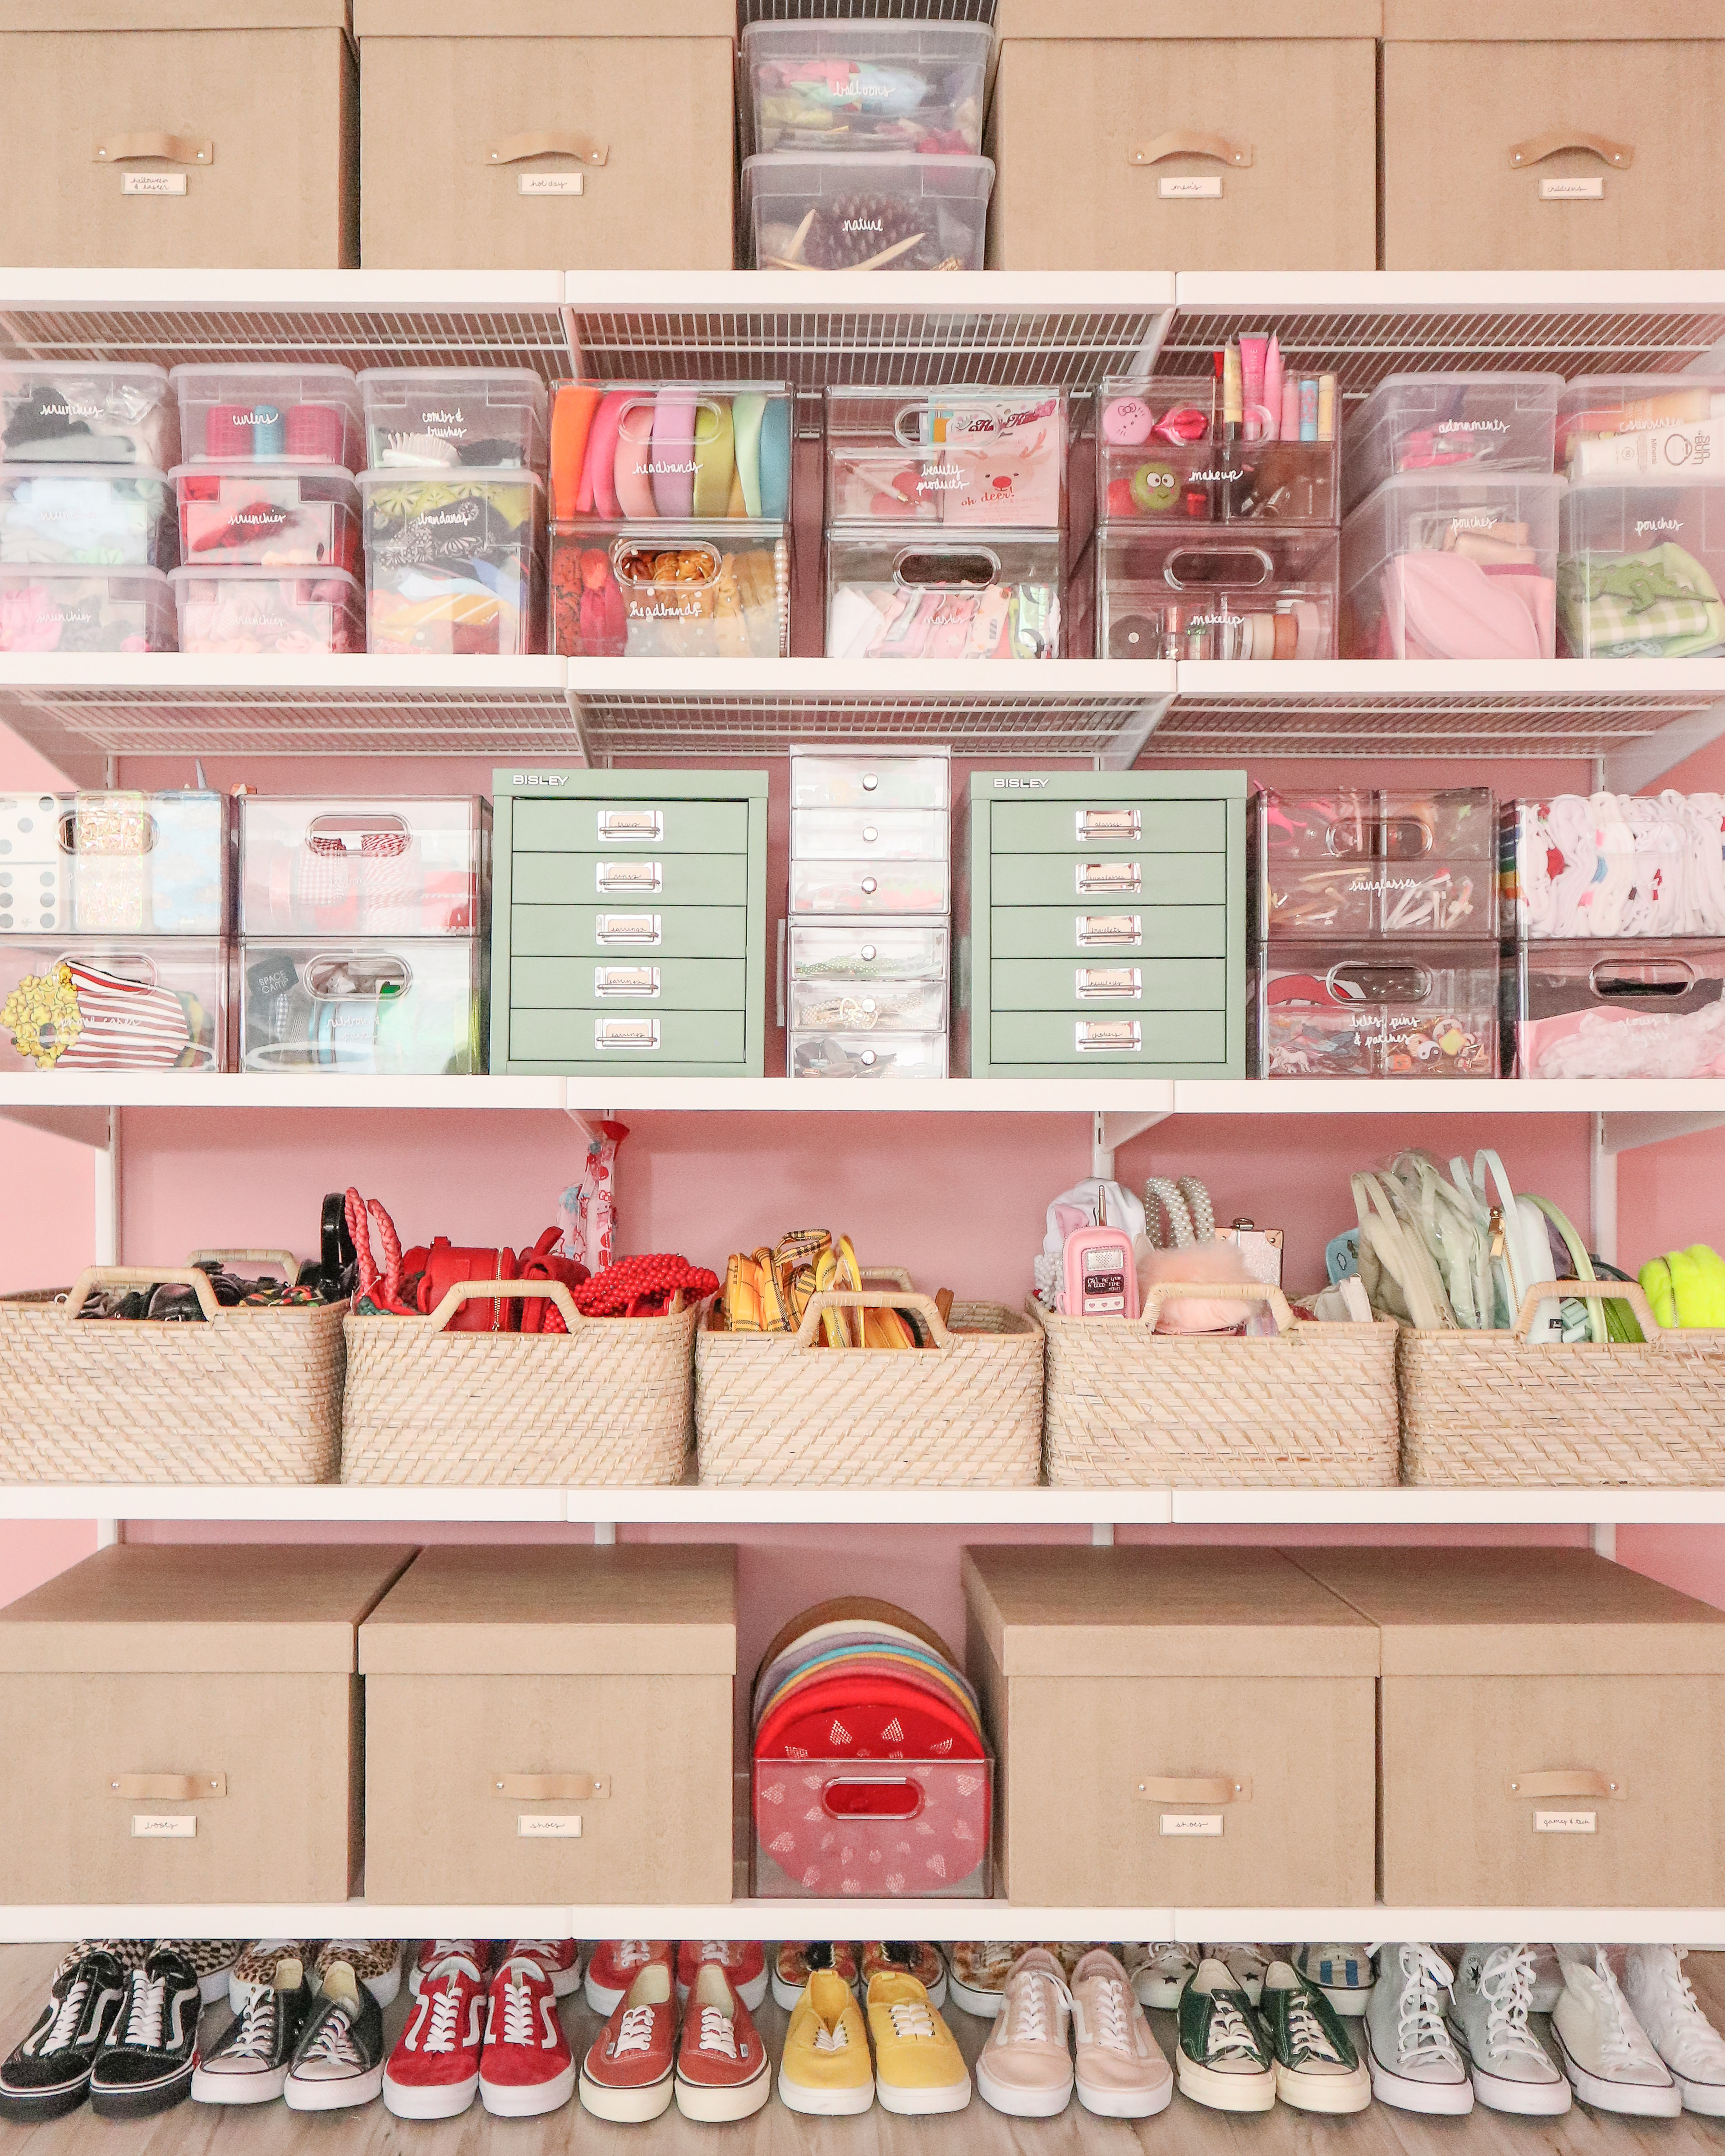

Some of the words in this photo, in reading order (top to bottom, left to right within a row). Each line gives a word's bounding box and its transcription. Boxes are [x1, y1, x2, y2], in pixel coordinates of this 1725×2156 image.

[833, 80, 896, 97] balloons
[842, 217, 883, 232] nature
[39, 403, 104, 416] scrunchies
[422, 409, 455, 424] combs
[456, 407, 464, 423] &
[232, 412, 279, 426] curlers
[1439, 419, 1511, 434] adornments
[425, 425, 468, 438] brushes
[632, 460, 704, 475] headbands
[921, 463, 965, 481] beauty
[1188, 468, 1244, 483] makeup
[916, 478, 970, 496] products
[227, 509, 287, 525] scrunchies
[417, 511, 471, 526] bandanas
[1450, 516, 1497, 536] pouches
[1634, 517, 1684, 537] pouches
[36, 609, 92, 623] scrunchies
[629, 602, 703, 618] headbands
[1190, 613, 1245, 629] makeup
[512, 774, 569, 786] BISLEY
[993, 778, 1050, 788] BISLEY
[1349, 878, 1422, 897] sunglasses
[611, 924, 647, 933] earrings
[258, 970, 285, 986] SPACE
[262, 977, 289, 993] CAMP
[60, 1016, 96, 1032] phone
[103, 1017, 142, 1026] cases
[326, 1015, 370, 1028] ribbon
[1389, 1013, 1421, 1030] pins
[1353, 1032, 1362, 1046] &
[1364, 1033, 1417, 1049] patches
[1543, 1819, 1568, 1827] games
